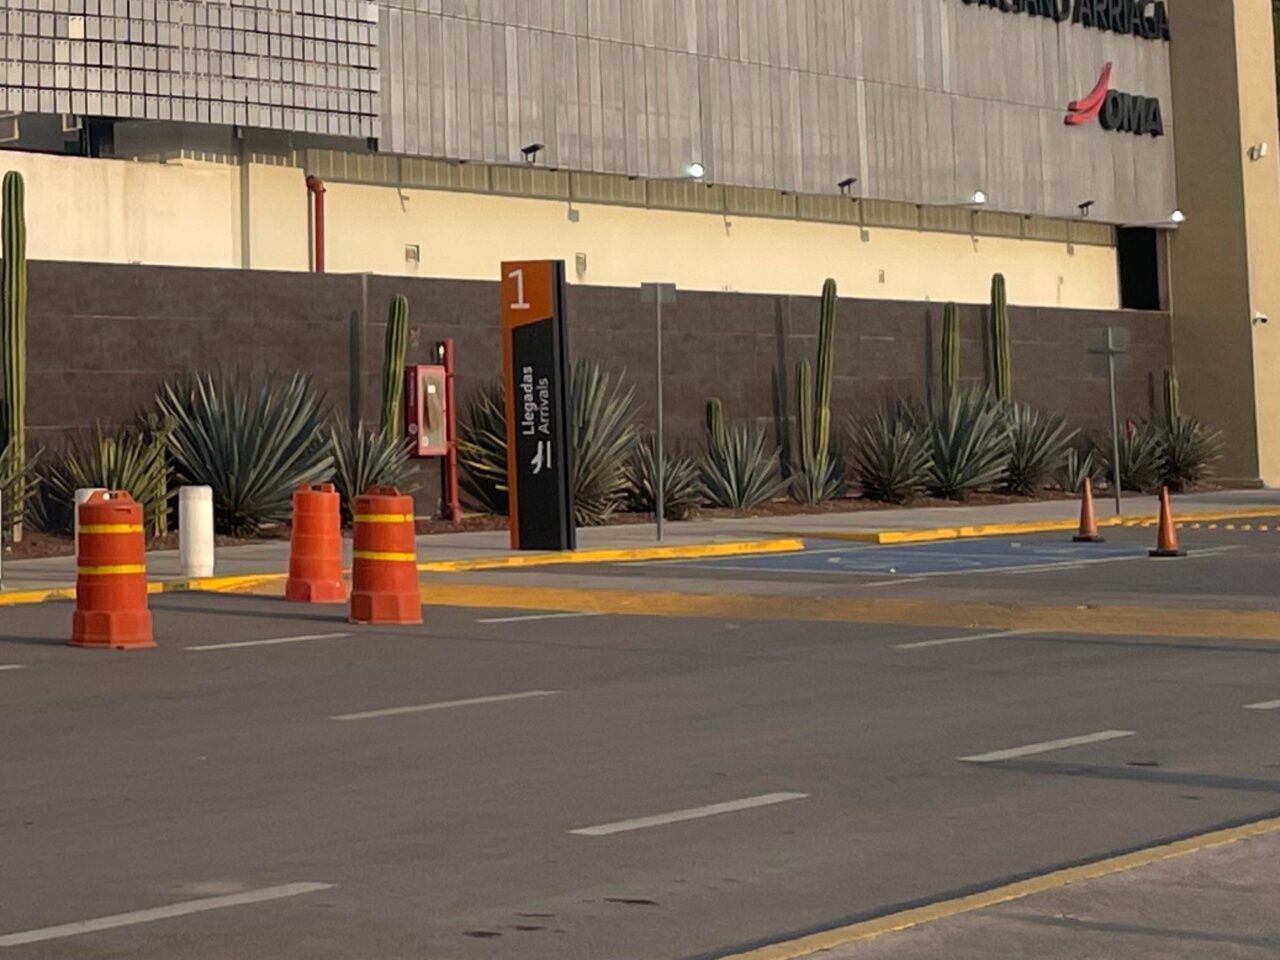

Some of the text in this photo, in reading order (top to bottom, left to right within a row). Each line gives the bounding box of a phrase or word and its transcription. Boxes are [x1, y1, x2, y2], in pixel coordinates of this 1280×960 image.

[1099, 89, 1164, 138] OMA
[508, 269, 531, 310] 1
[521, 366, 537, 435] Llegadas
[536, 377, 550, 434] Arrivals
